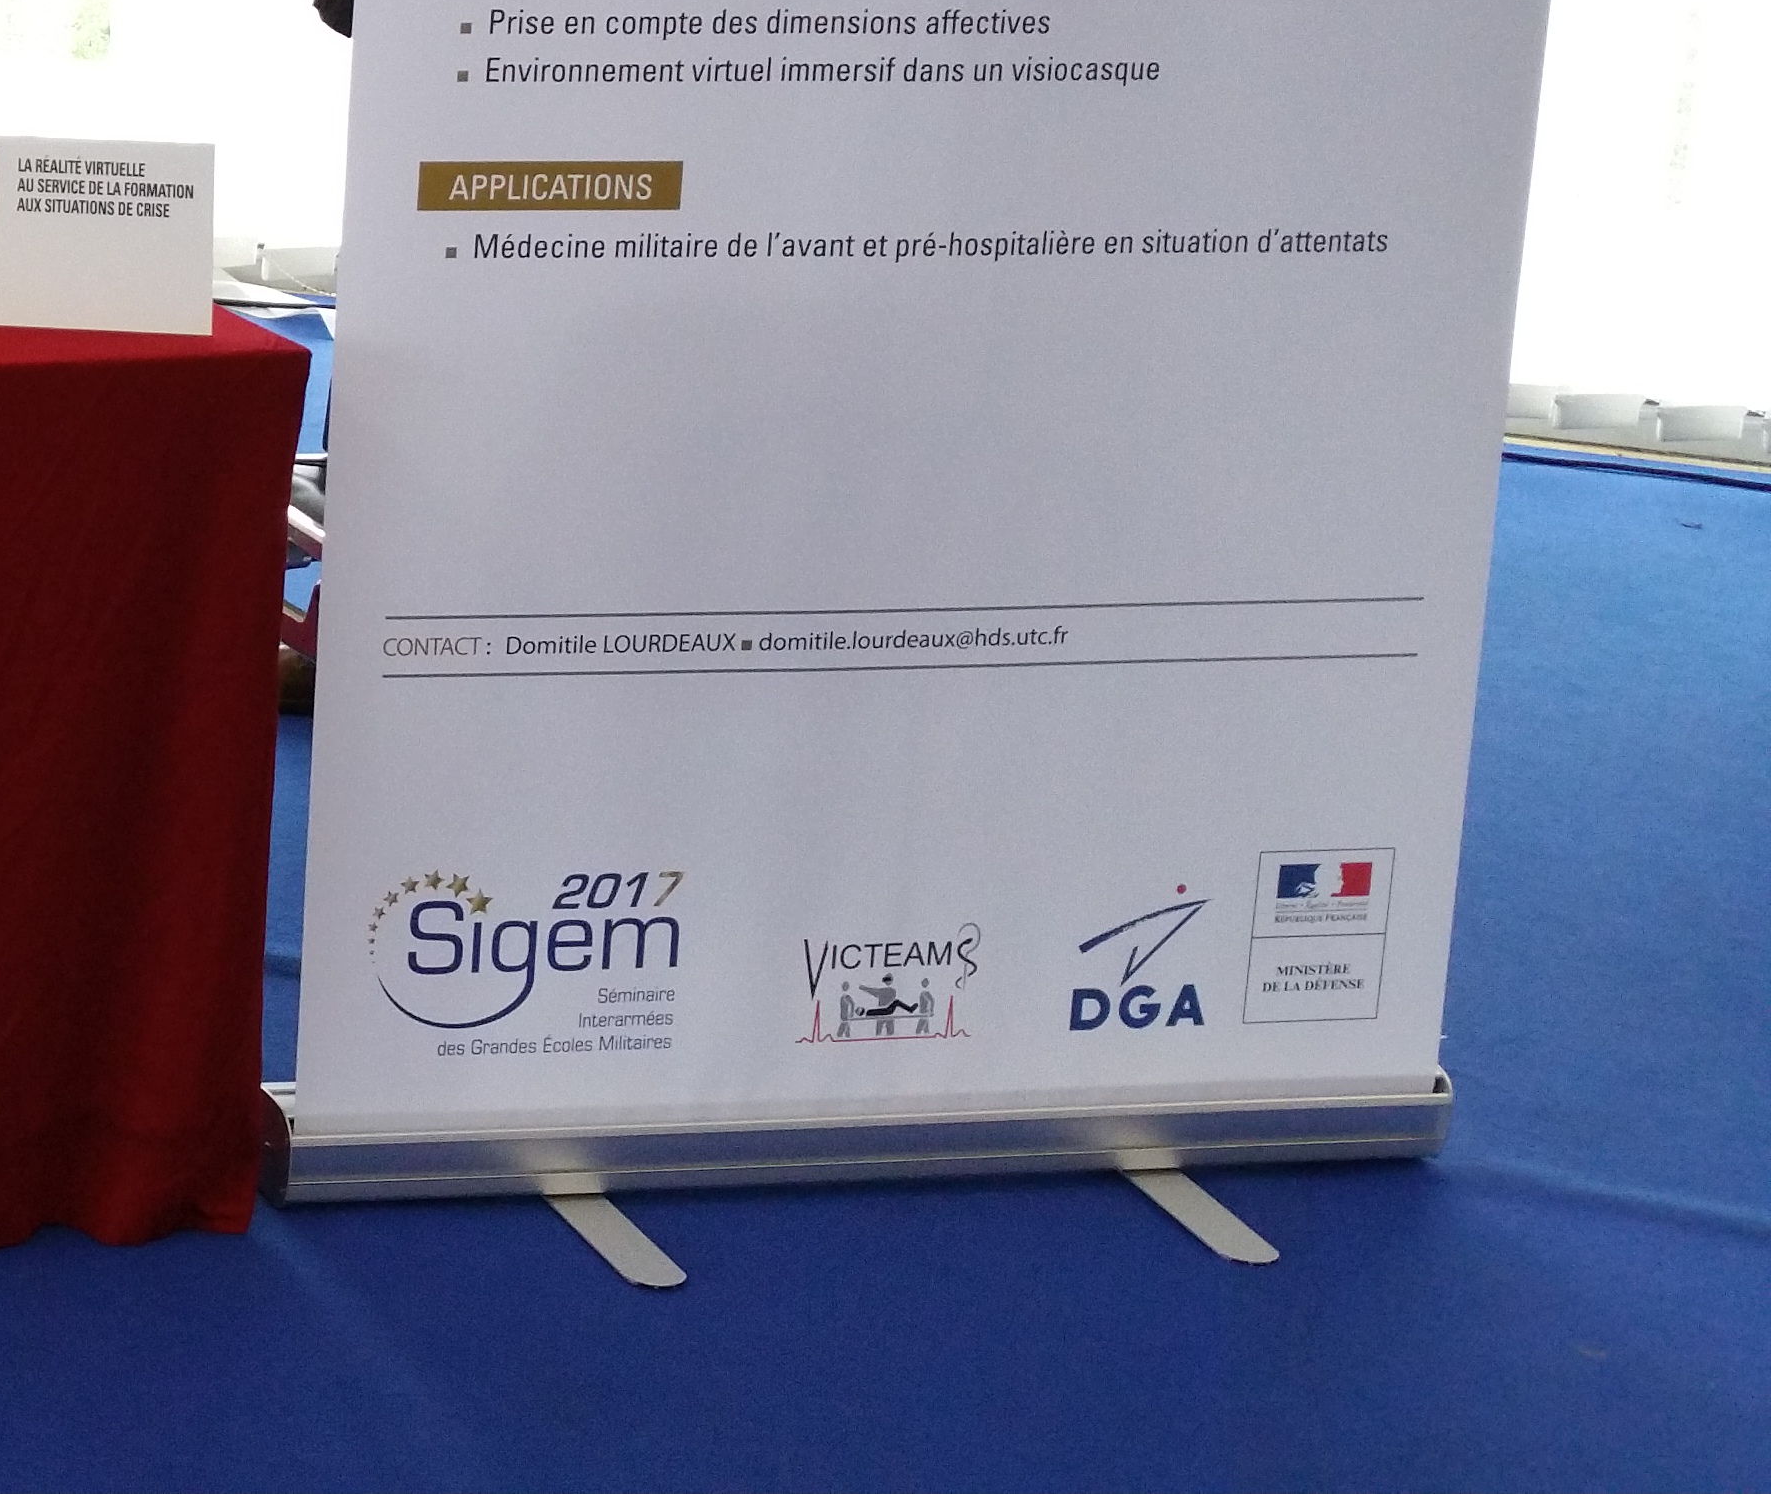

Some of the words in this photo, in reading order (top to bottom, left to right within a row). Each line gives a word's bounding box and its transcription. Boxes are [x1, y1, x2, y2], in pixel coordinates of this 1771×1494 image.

[490, 9, 554, 34] Prise
[565, 16, 594, 34] en
[606, 13, 702, 40] compte
[713, 9, 757, 34] des
[767, 9, 916, 35] dimensions
[926, 9, 1050, 34] affectives
[486, 57, 684, 82] Environnement
[692, 57, 771, 82] virtuel
[781, 57, 895, 82] immersif
[904, 57, 964, 82] dans
[974, 63, 1002, 82] un
[1012, 56, 1159, 86] visiocasque
[18, 158, 32, 172] LA
[36, 159, 81, 175] RÉALITÉ
[85, 161, 145, 177] VIRTUELLE
[17, 178, 34, 192] AU
[37, 178, 85, 194] SERVICE
[89, 181, 103, 195] DE
[107, 182, 121, 196] LA
[124, 182, 194, 199] FORMATION
[449, 174, 652, 200] APPLICATIONS
[17, 198, 41, 212] AUX
[45, 199, 114, 215] SITUATIONS
[118, 202, 133, 216] DE
[136, 202, 169, 218] CRISE
[474, 234, 605, 258] Médecine
[615, 233, 717, 258] militaire
[728, 233, 757, 257] de
[863, 236, 888, 257] et
[895, 230, 1095, 263] pré-hospitalière
[1105, 236, 1133, 254] en
[1142, 229, 1248, 254] situation
[506, 635, 596, 655] Domitile
[604, 633, 736, 653] LOURDEAUX
[759, 625, 1068, 651] domitile.lourdeaux@hds.utc.fr
[552, 872, 682, 909] 2017
[407, 899, 681, 996] Sigem
[804, 922, 981, 999] VICTEAMS
[1277, 964, 1348, 976] MINISTÈRE
[598, 988, 675, 1004] Séminaire
[1263, 982, 1278, 992] DE
[1284, 981, 1300, 991] LA
[1305, 978, 1362, 990] DÉFENSE
[579, 1011, 673, 1028] Interarmées
[1069, 984, 1204, 1031] DGA
[437, 1041, 465, 1056] des
[471, 1039, 536, 1055] Grandes
[543, 1035, 593, 1053] Écoles
[599, 1035, 672, 1051] Militaires
